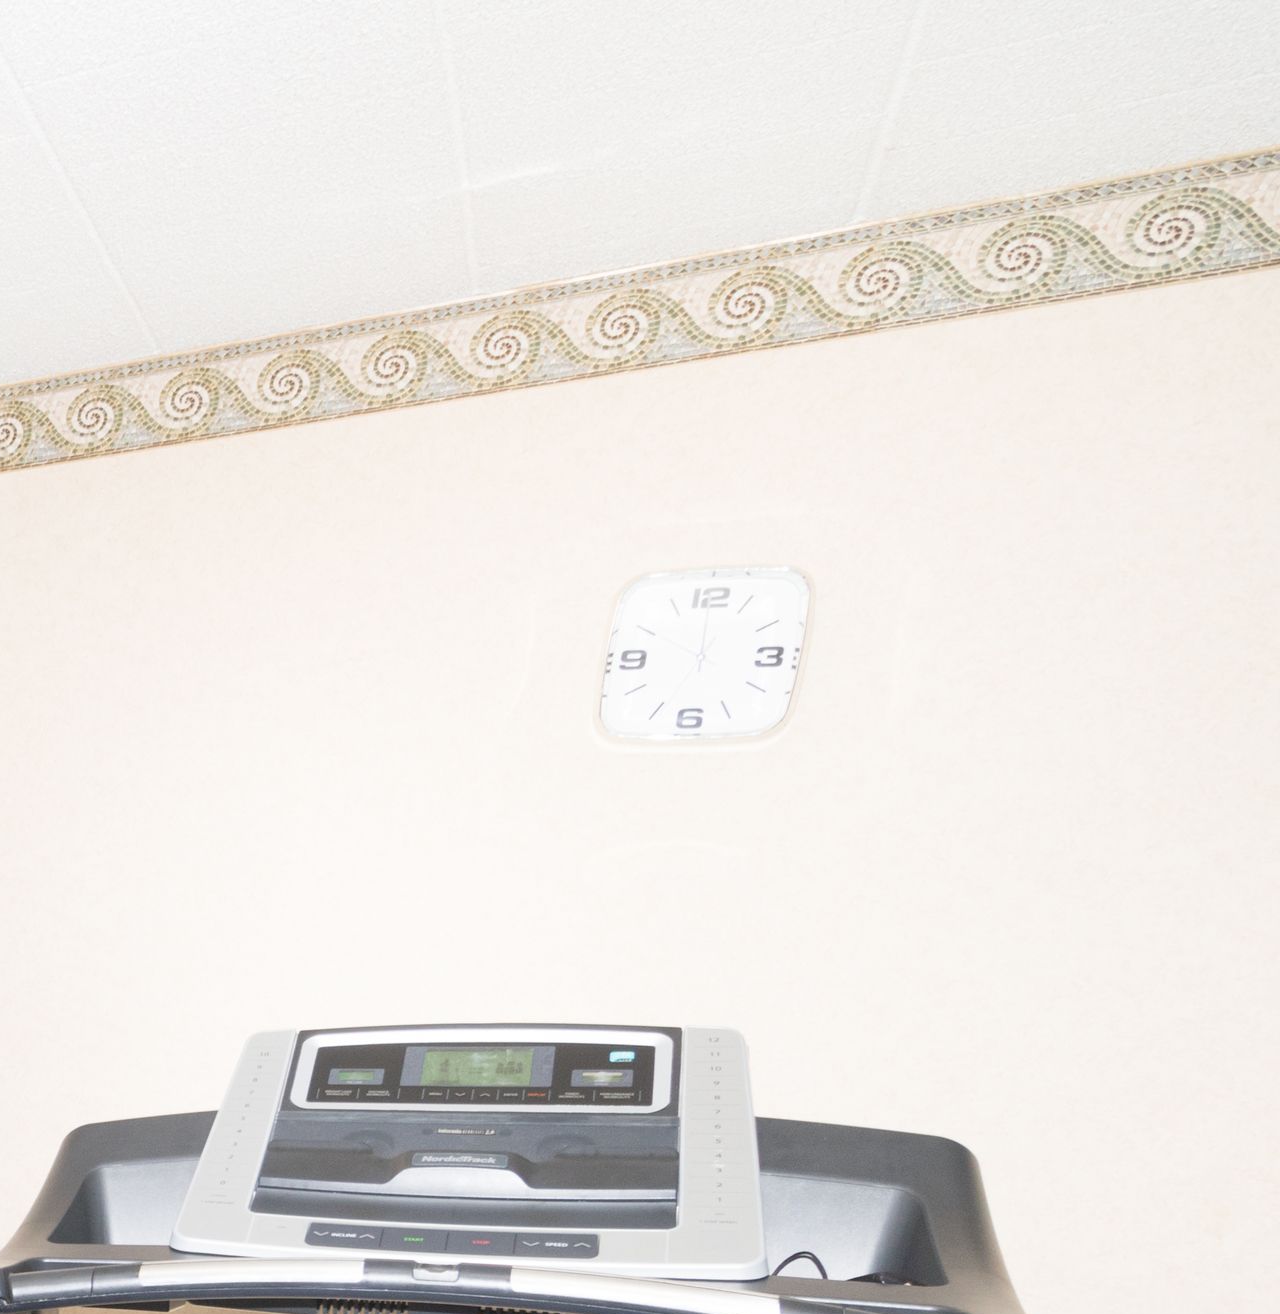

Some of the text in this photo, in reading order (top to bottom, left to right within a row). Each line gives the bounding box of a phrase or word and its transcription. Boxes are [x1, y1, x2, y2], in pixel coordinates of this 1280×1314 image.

[691, 587, 731, 609] 12
[619, 650, 647, 670] 9
[754, 646, 784, 667] 3
[676, 708, 703, 728] 6
[421, 1155, 497, 1164] NordicTrack
